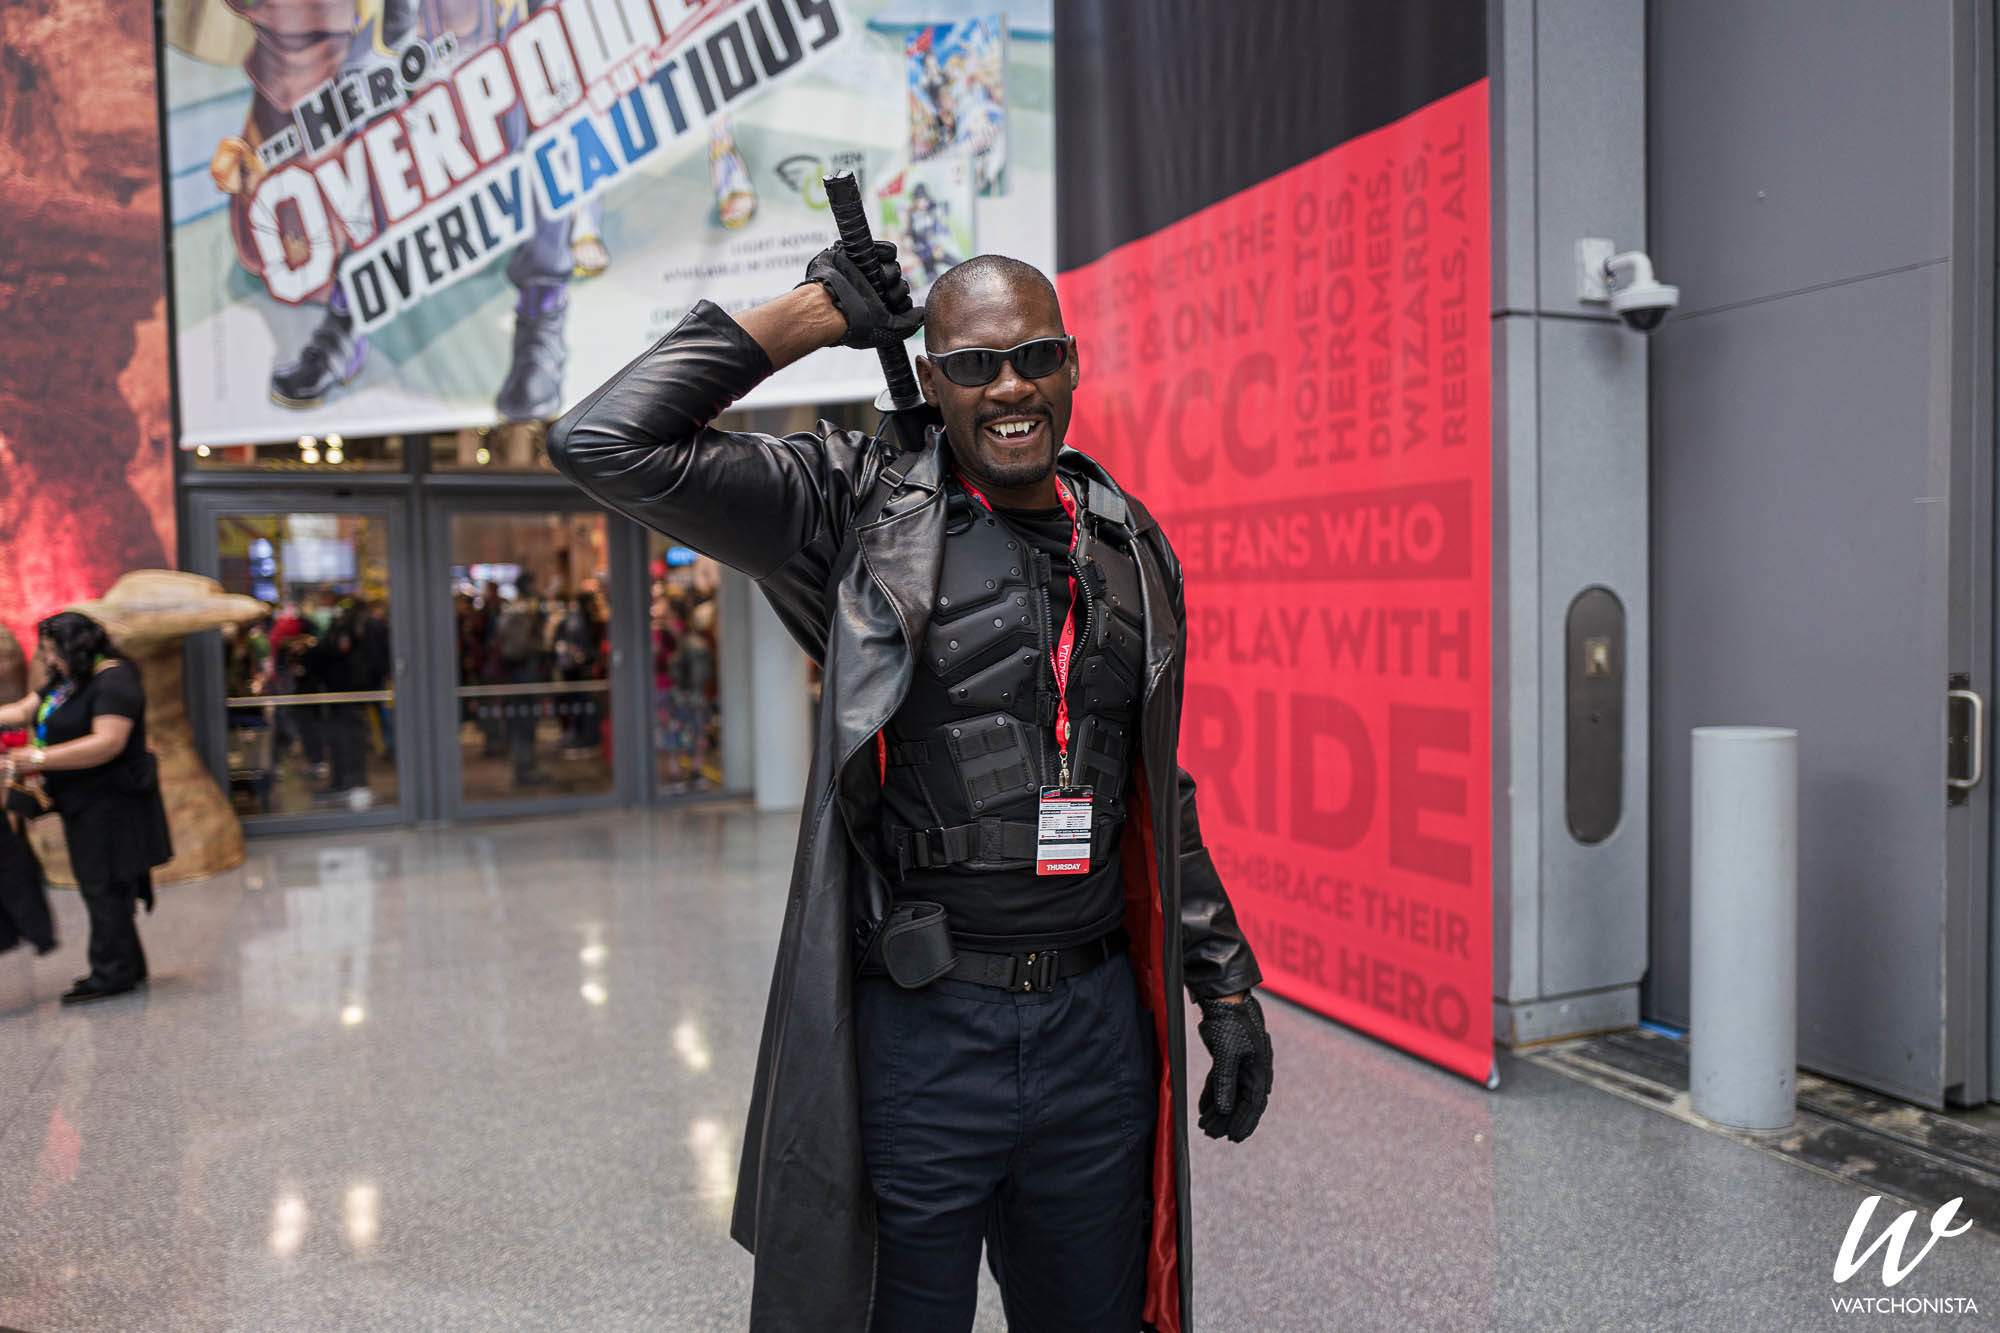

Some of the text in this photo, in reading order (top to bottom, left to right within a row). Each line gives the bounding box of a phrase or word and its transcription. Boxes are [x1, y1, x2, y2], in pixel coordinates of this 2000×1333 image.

[250, 0, 706, 304] OVERPOW
[300, 45, 426, 152] HERO
[351, 166, 524, 323] OVERLY
[535, 0, 840, 210] CAUTIOUS
[1140, 312, 1165, 364] &
[1174, 270, 1275, 354] ONLY
[1180, 240, 1215, 283] TO
[1220, 211, 1275, 266] THE
[1326, 171, 1358, 463] HEROES,
[1366, 157, 1395, 458] DREAMERS,
[1401, 141, 1432, 452] WIZARDS,
[1440, 124, 1470, 448] REBELS, ALL
[1293, 191, 1319, 468] HOME TO
[1213, 512, 1310, 573] FANS
[1319, 501, 1446, 566] WHO
[1186, 606, 1471, 682] SPLAY WITH
[1185, 682, 1472, 887] RIDE
[1046, 863, 1081, 871] THURSDAY
[1214, 842, 1470, 961] EMBRACE THEIR
[1339, 946, 1470, 1042] HERO
